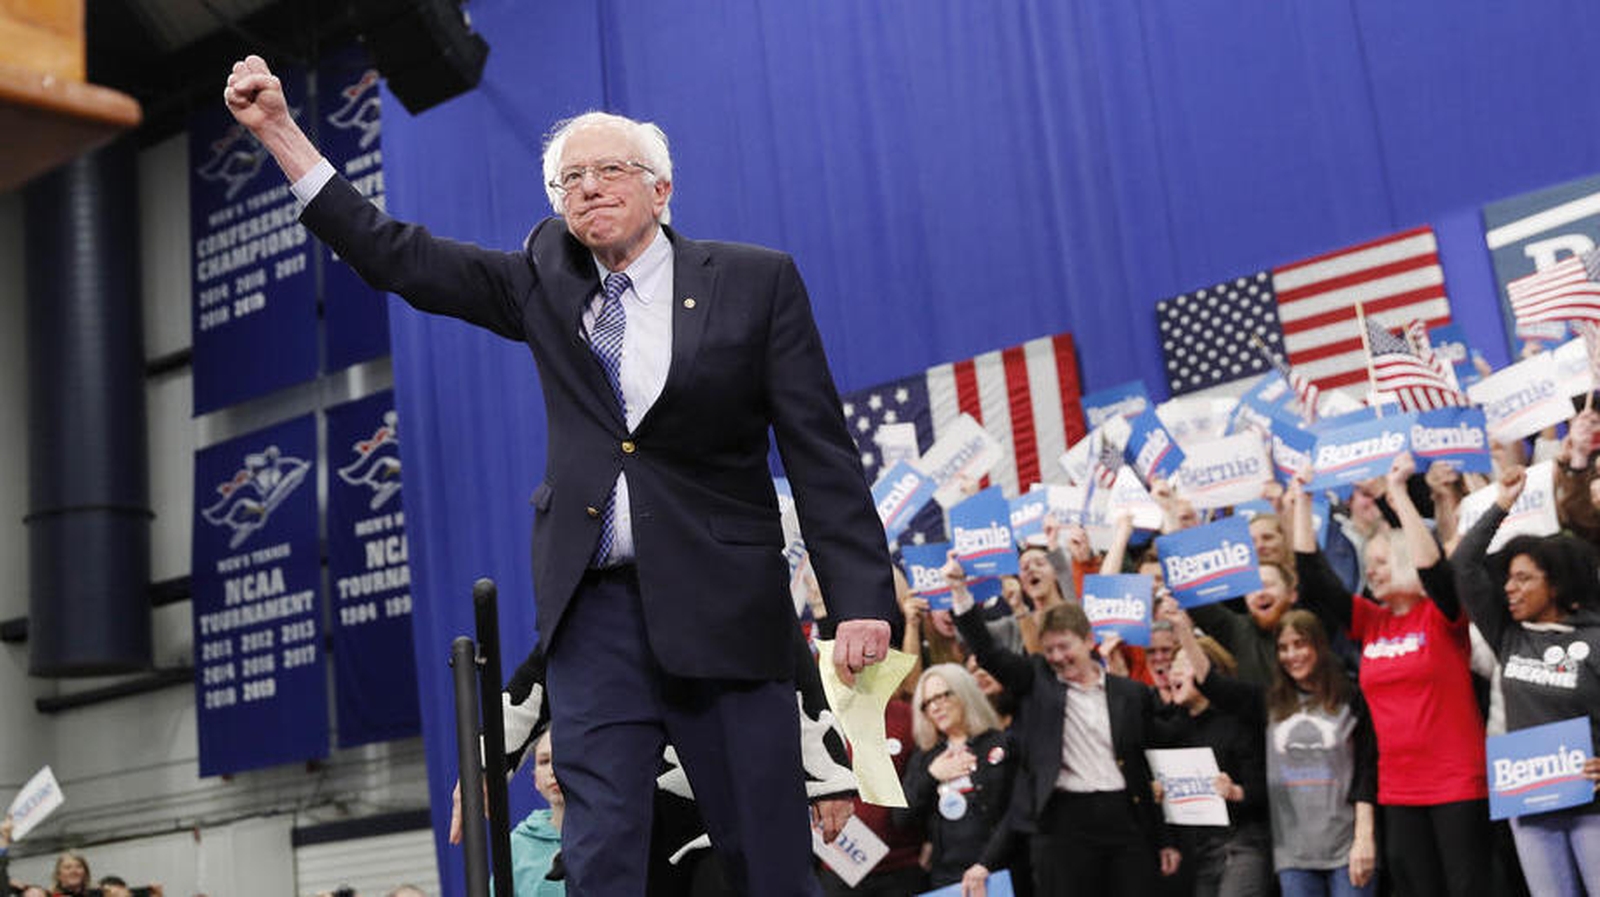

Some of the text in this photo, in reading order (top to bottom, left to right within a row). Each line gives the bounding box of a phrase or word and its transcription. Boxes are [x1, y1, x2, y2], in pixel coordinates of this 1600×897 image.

[198, 222, 307, 282] CHAMPIONS
[1410, 422, 1485, 450] Bernie
[1178, 451, 1260, 490] Bernie
[338, 566, 410, 599] TOURNA
[1164, 539, 1251, 589] Bernie
[225, 566, 286, 606] NCAA
[201, 590, 315, 635] TOURNAMENT
[1083, 592, 1147, 624] Bernie
[1493, 744, 1586, 792] Bernie
